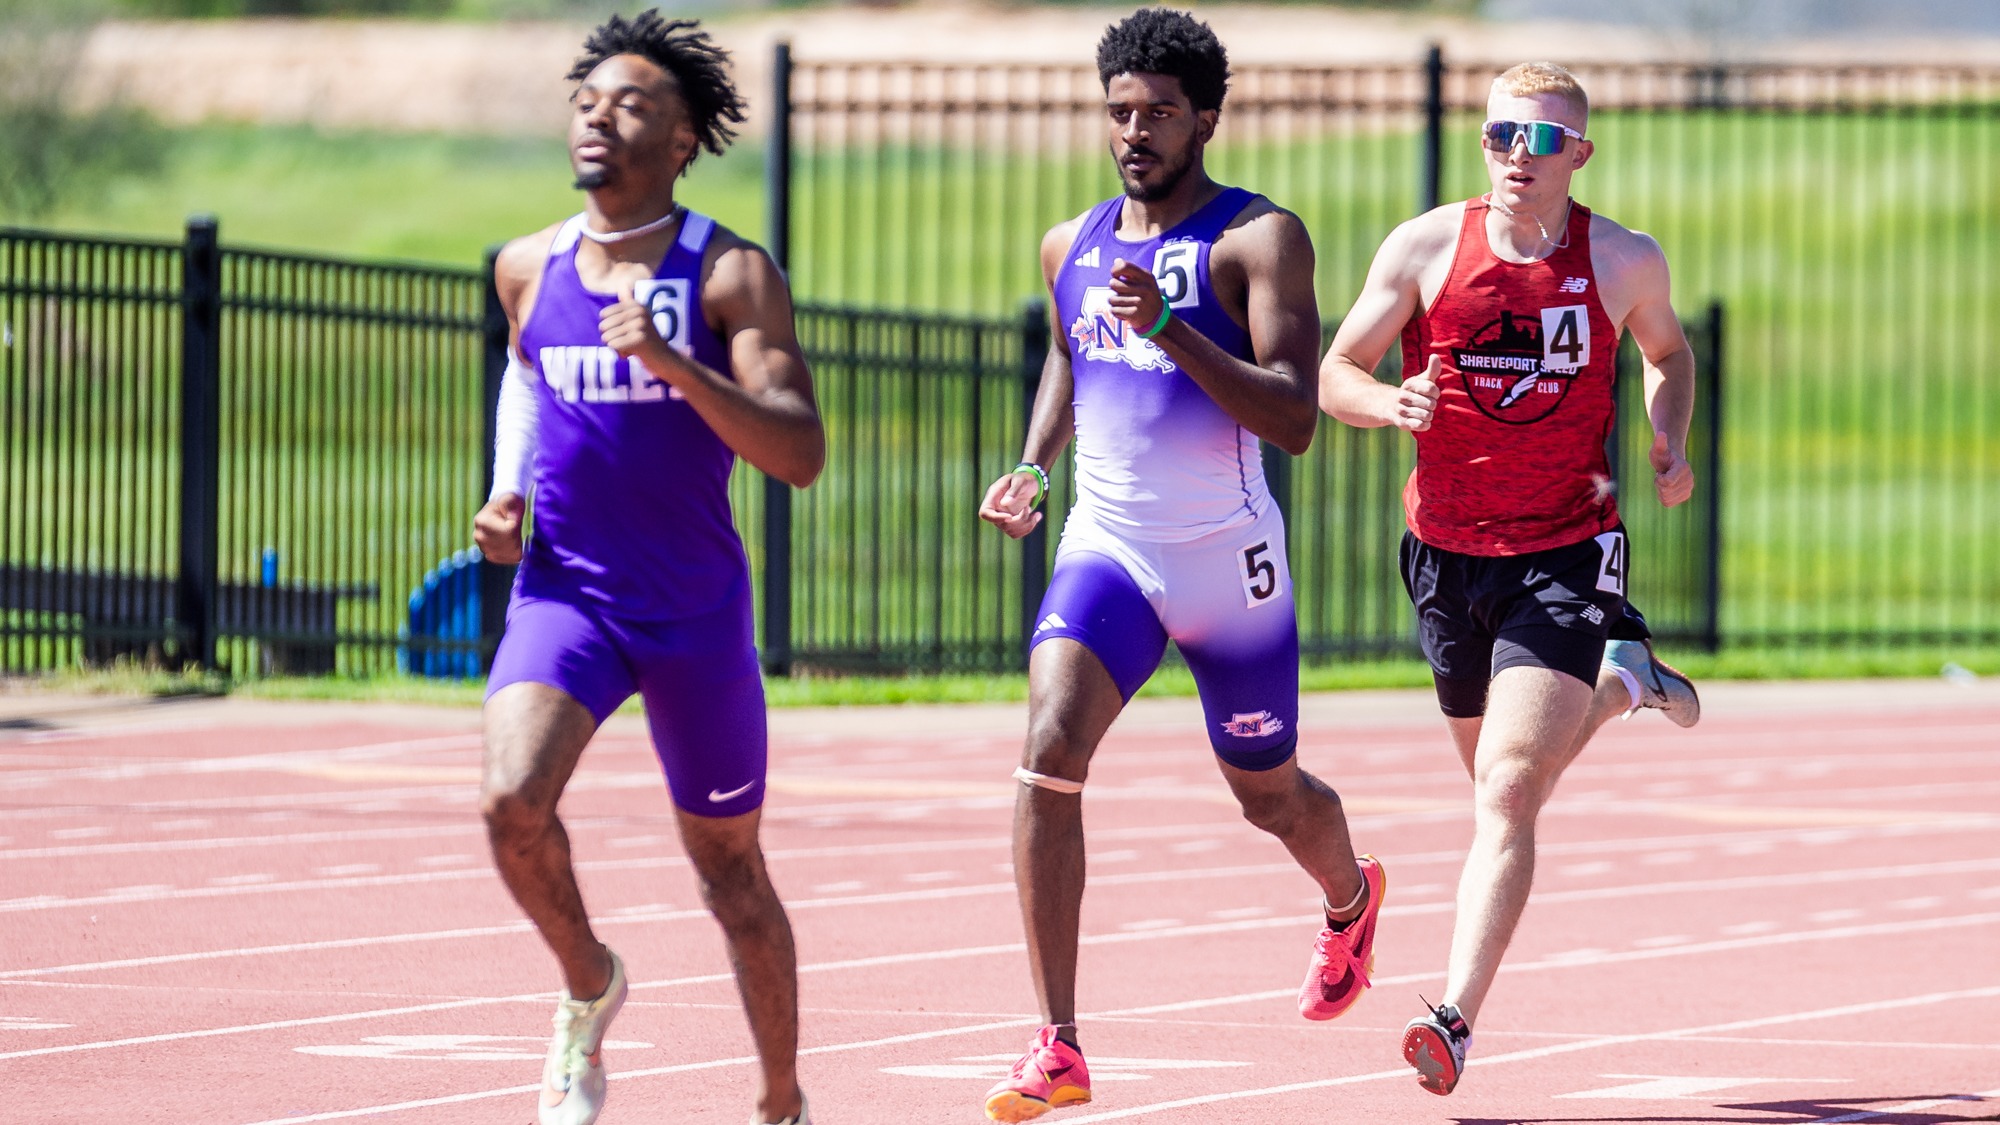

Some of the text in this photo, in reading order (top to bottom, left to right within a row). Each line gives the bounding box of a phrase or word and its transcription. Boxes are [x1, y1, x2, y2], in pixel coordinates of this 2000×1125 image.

[1158, 248, 1188, 303] 5
[649, 284, 678, 342] 6
[1549, 309, 1583, 363] 4
[539, 346, 696, 402] WILE
[1459, 353, 1538, 372] SHREVEPORT
[1474, 376, 1559, 394] TRACK CLUB
[1244, 541, 1275, 600] 5
[1604, 535, 1622, 591] 4
